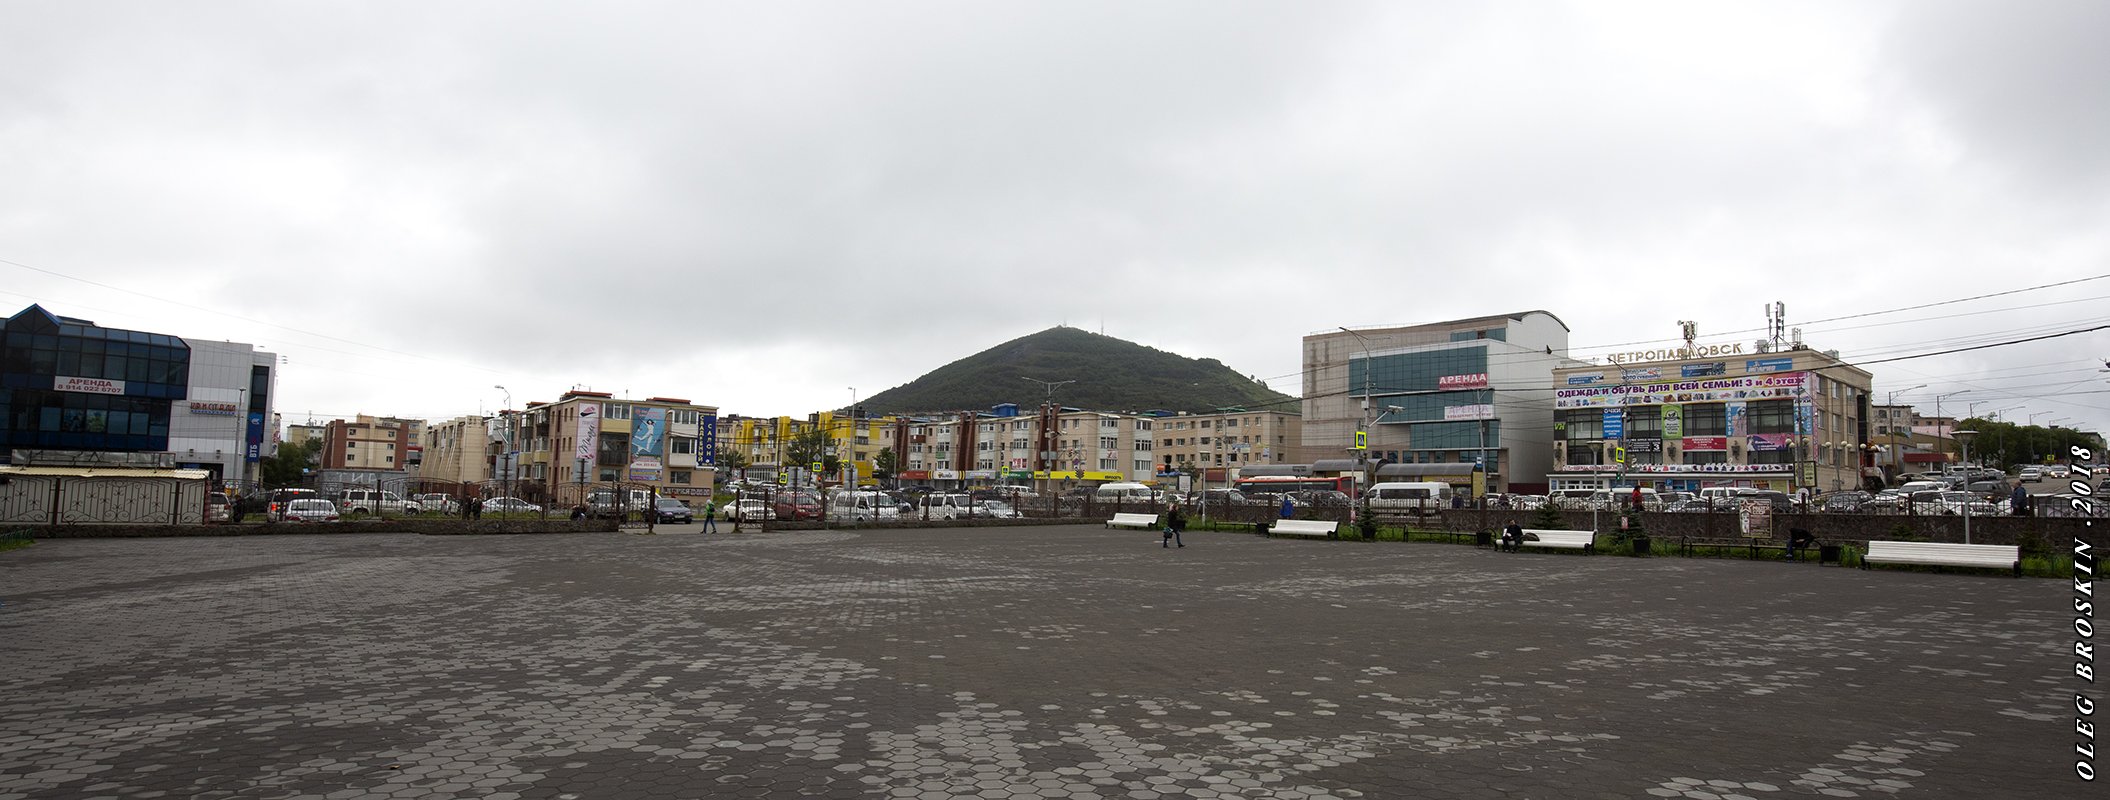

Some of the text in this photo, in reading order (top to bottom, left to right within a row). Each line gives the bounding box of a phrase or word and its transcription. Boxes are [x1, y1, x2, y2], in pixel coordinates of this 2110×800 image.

[1608, 343, 1741, 363] ПЕТРОПАВЛОВСК
[69, 379, 112, 387] АРЕНДА
[1440, 374, 1486, 384] АРЕНДА
[1558, 388, 1599, 398] ОДЕЖДА
[1612, 384, 1646, 395] ОБУВЬ
[1648, 384, 1670, 393] ДЛЯ
[1673, 380, 1699, 391] ВСЕЙ
[1702, 380, 1742, 389] СЕМЬИ!
[1746, 379, 1753, 387] 3
[1766, 377, 1774, 385] 4
[1776, 376, 1805, 385] этаж
